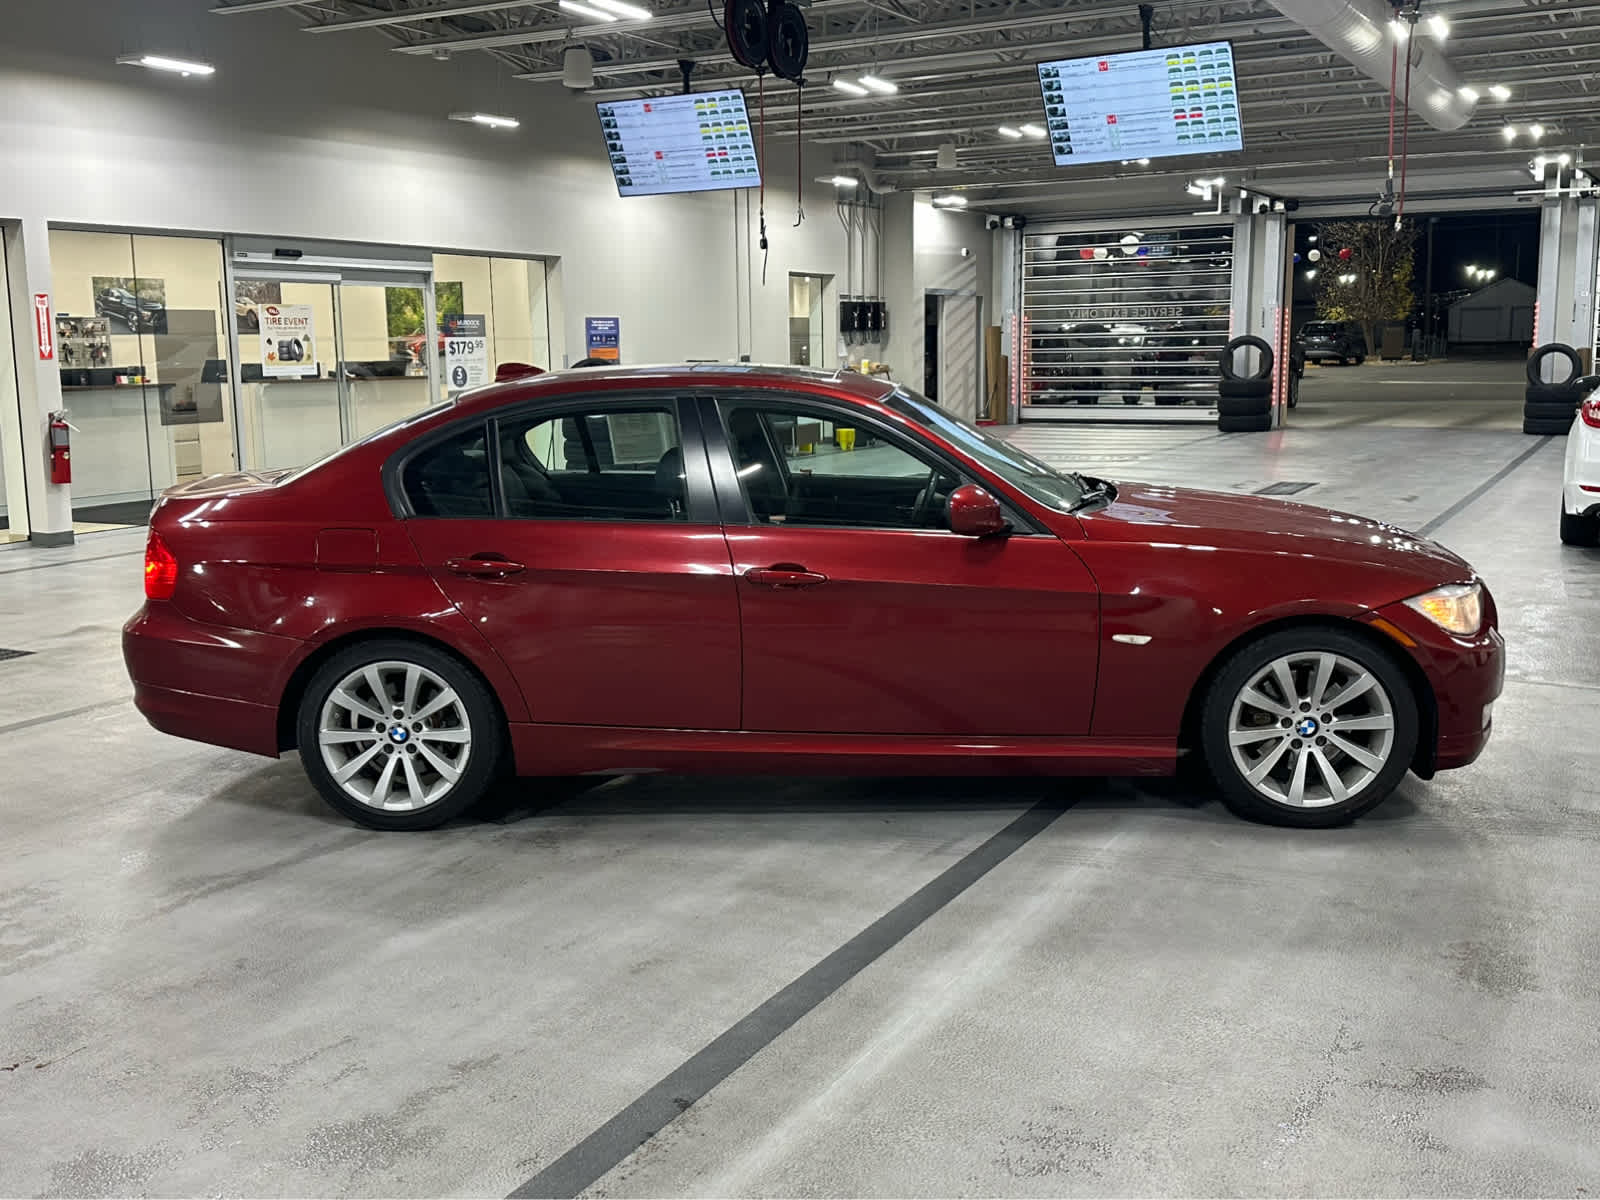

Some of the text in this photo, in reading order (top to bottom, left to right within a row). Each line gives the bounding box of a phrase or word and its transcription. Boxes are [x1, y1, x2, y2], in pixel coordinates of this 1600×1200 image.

[265, 317, 308, 326] TIRE EVENT
[456, 368, 463, 379] 3
